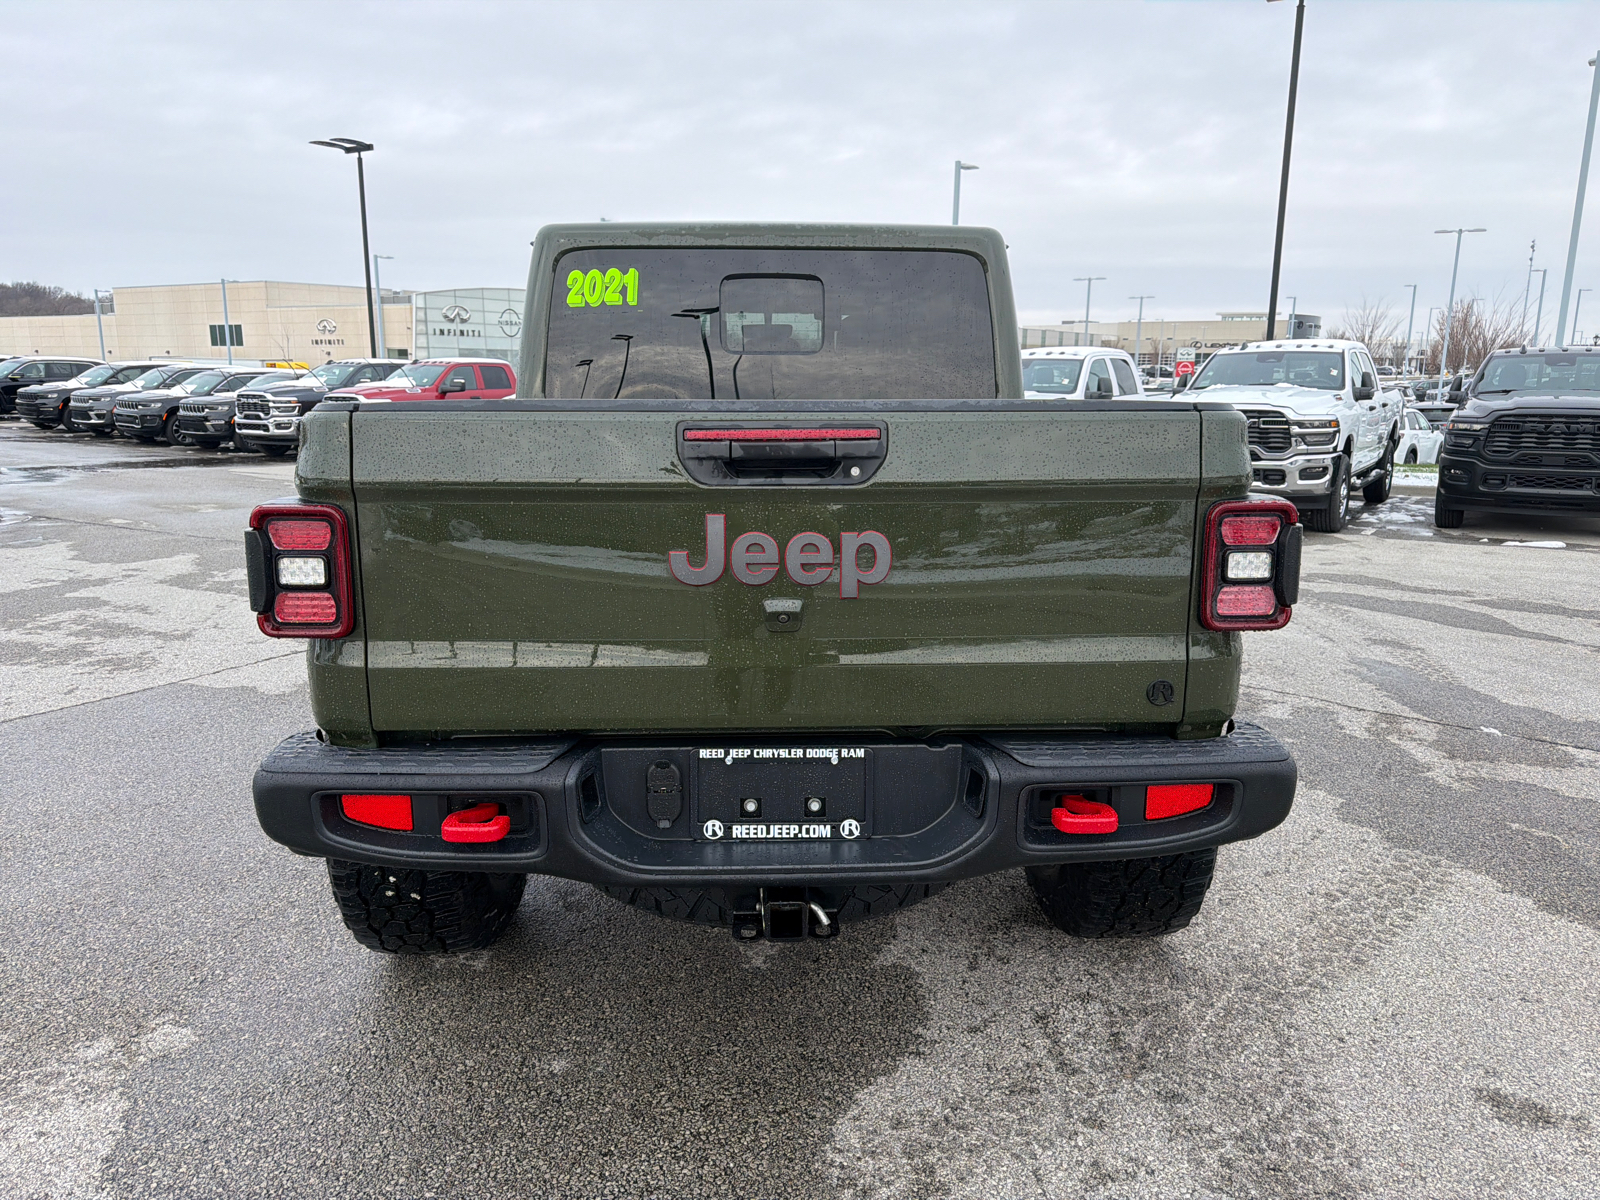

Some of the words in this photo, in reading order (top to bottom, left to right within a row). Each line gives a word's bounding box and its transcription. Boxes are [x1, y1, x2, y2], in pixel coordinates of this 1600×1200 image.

[566, 268, 639, 307] 2021
[432, 328, 481, 337] INFINITI
[1524, 423, 1593, 433] RAM
[668, 513, 892, 599] Jeep
[699, 748, 725, 758] REED
[728, 748, 751, 759] JEEP
[753, 748, 804, 758] CHRYSLER
[806, 748, 839, 758] DODGE
[841, 748, 865, 758] RAM
[732, 824, 831, 838] REEDJEEP.COM
